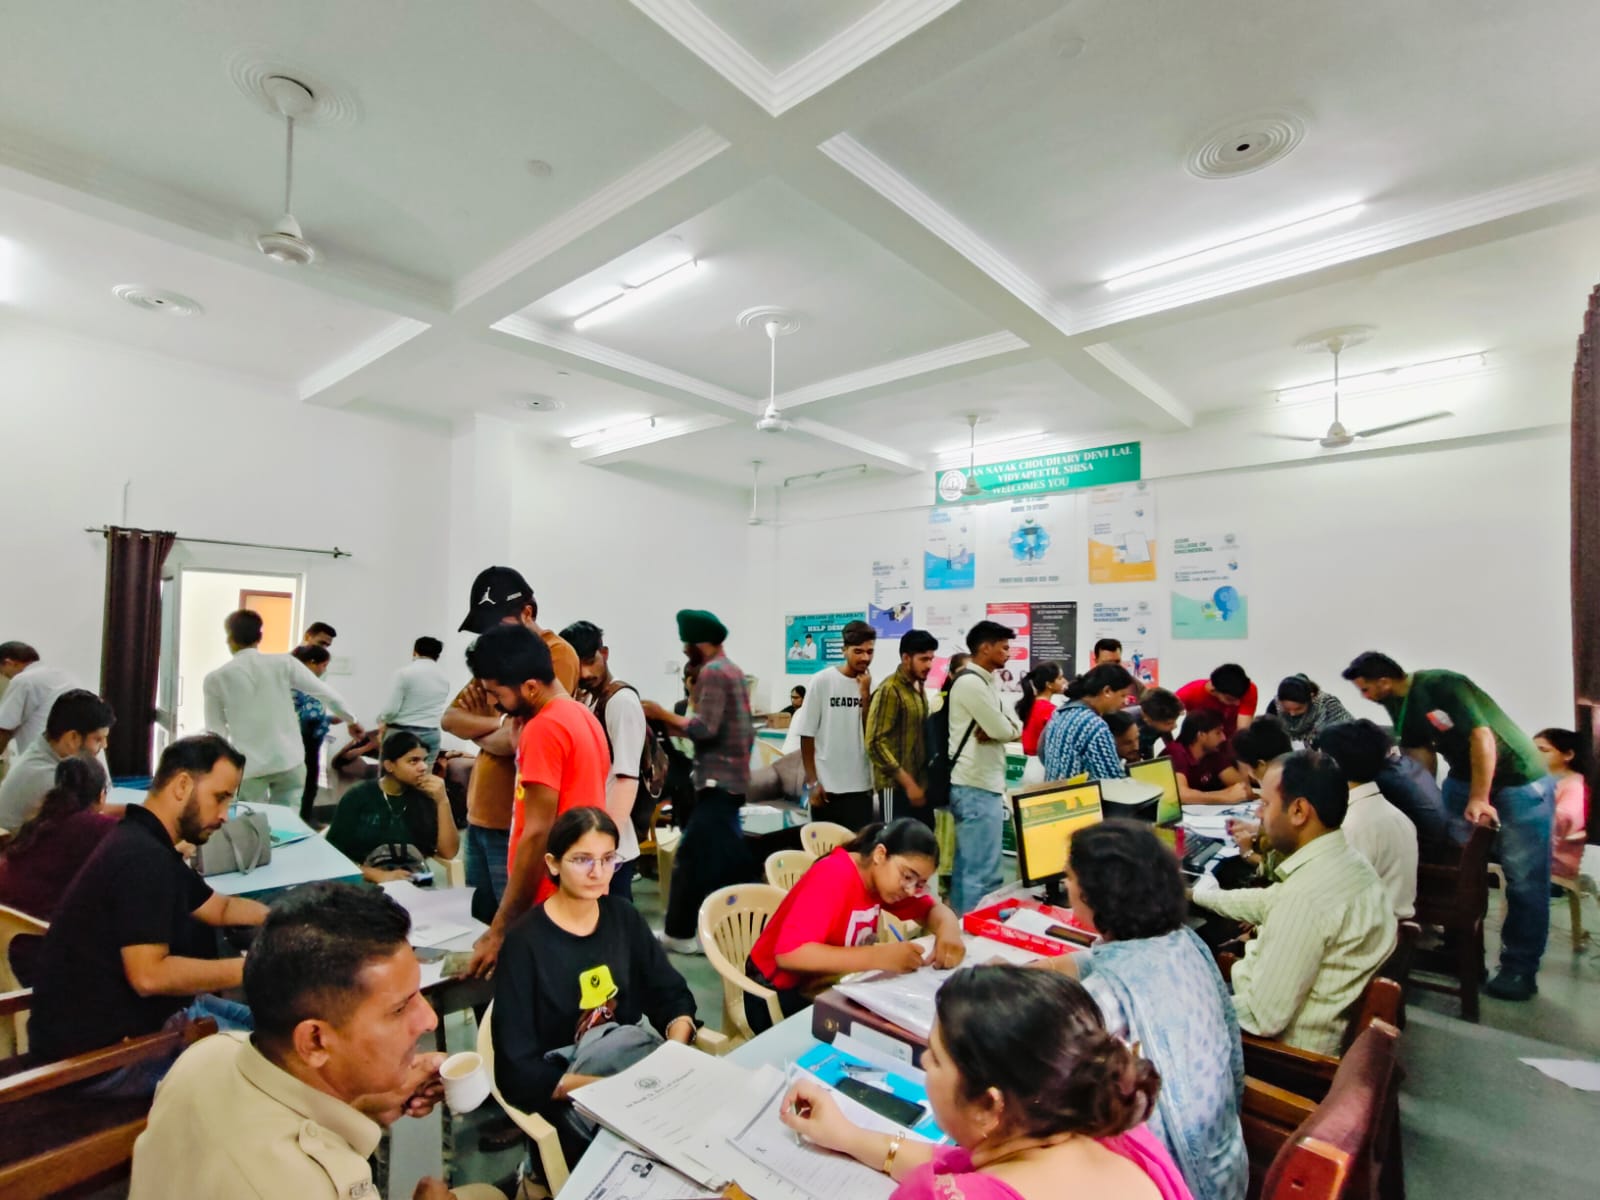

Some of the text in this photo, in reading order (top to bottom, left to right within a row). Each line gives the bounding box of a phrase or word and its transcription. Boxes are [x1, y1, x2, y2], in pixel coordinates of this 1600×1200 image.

[1018, 454, 1080, 469] CHOUDHARY
[1083, 449, 1109, 461] DEVI
[1111, 446, 1133, 457] LAL
[1048, 477, 1069, 489] YOU
